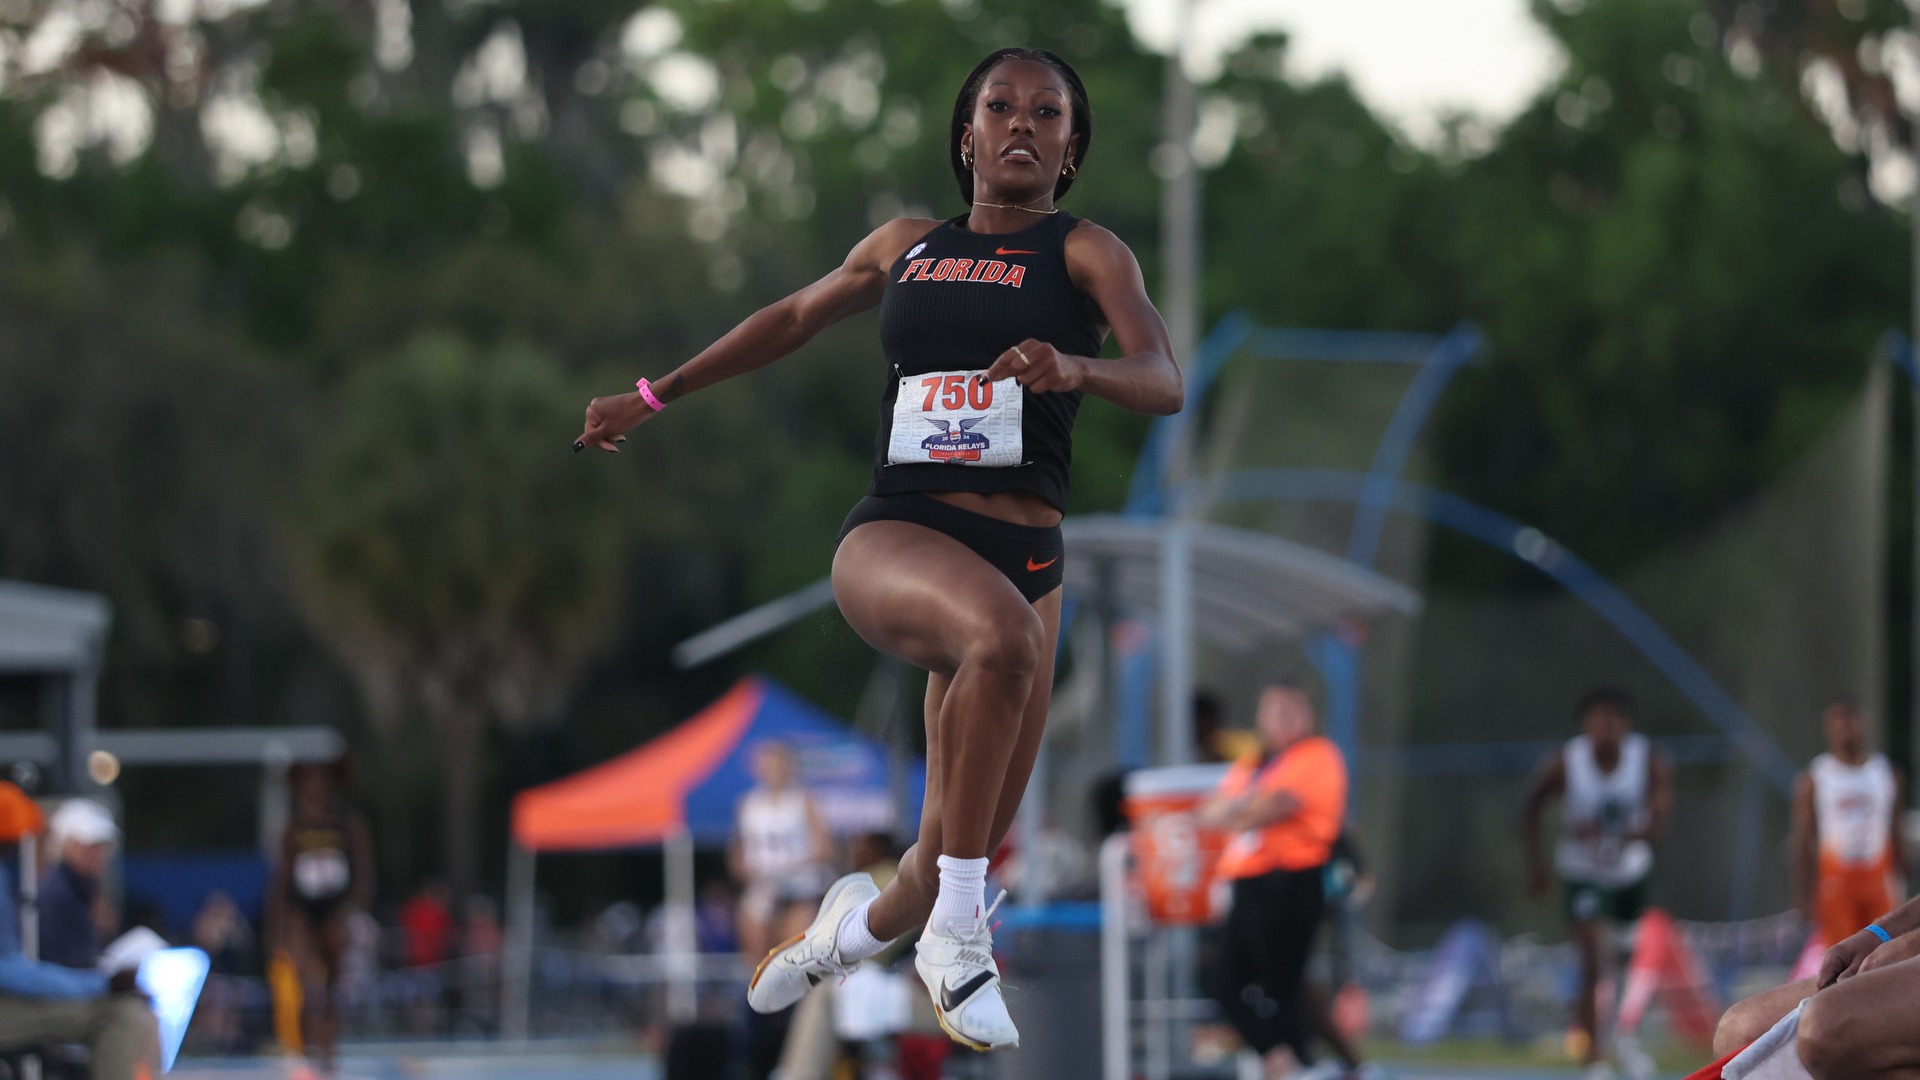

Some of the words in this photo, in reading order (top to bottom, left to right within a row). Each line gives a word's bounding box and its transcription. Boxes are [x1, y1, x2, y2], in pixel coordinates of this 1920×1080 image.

[897, 258, 1026, 288] FLORIDA
[921, 375, 993, 411] 750
[954, 948, 991, 966] NIKE
